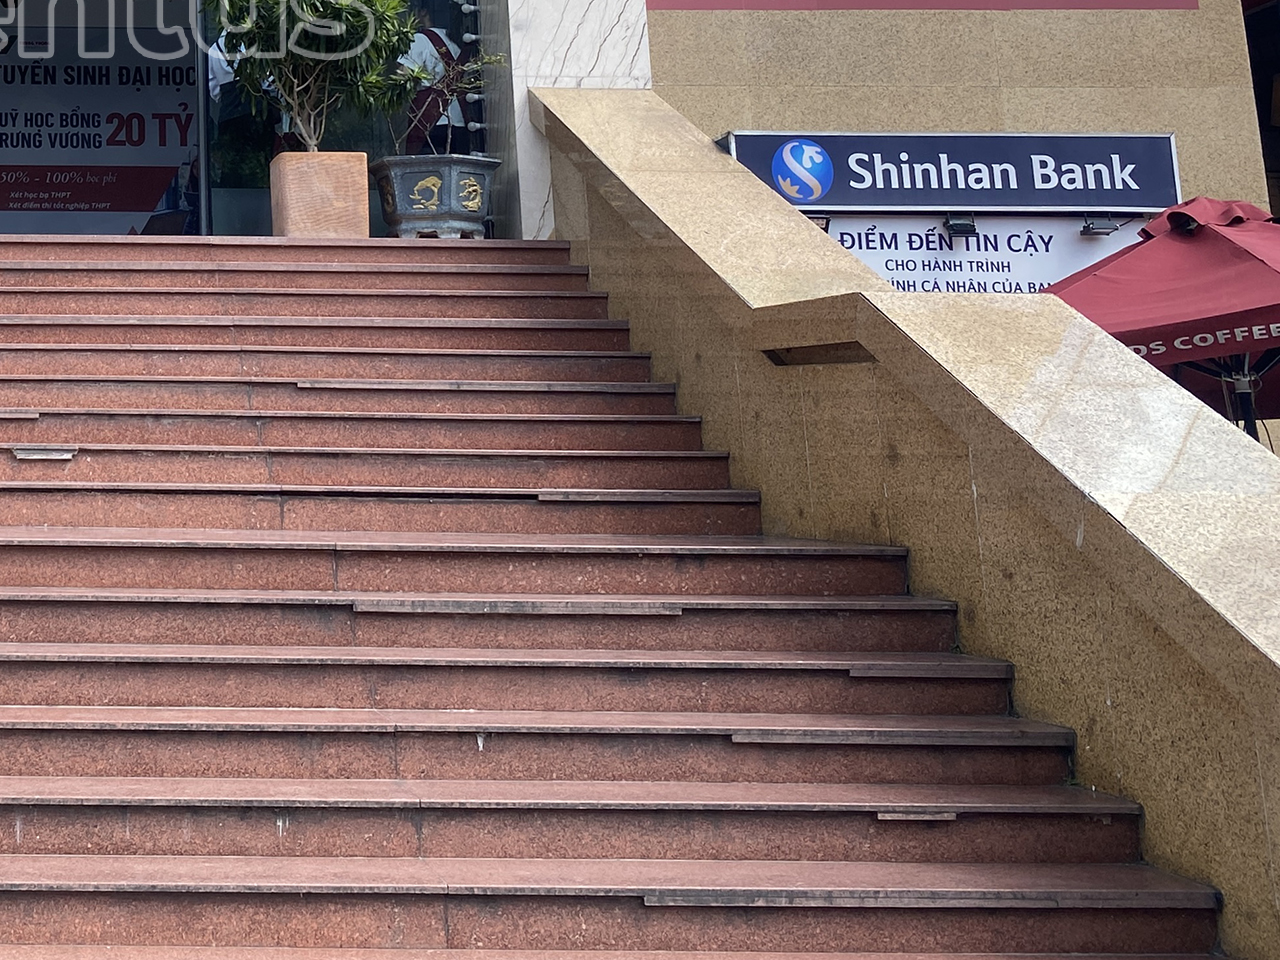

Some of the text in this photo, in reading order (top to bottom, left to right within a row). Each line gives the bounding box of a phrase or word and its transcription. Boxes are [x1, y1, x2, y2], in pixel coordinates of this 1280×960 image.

[63, 65, 110, 85] SINH
[117, 66, 151, 92] ĐẠI
[158, 66, 196, 92] HỌC
[24, 113, 54, 132] HỌC
[59, 106, 101, 128] BỔNG
[105, 102, 194, 147] 20 TỶ
[48, 131, 102, 149] VƯƠNG
[0, 171, 30, 184] 50%
[45, 171, 83, 184] 100%
[847, 152, 1140, 189] Shinhan Bank
[838, 224, 898, 250] ĐIỂM
[906, 226, 953, 251] ĐẾN
[1006, 230, 1054, 257] CẬY
[885, 259, 1011, 272] CHO HÀNH TRÌNH
[887, 277, 916, 292] ÍNH
[921, 278, 941, 292] CÁ
[946, 278, 987, 293] NHÂN
[992, 278, 1024, 293] CỦA
[1173, 324, 1280, 349] COFFEE
